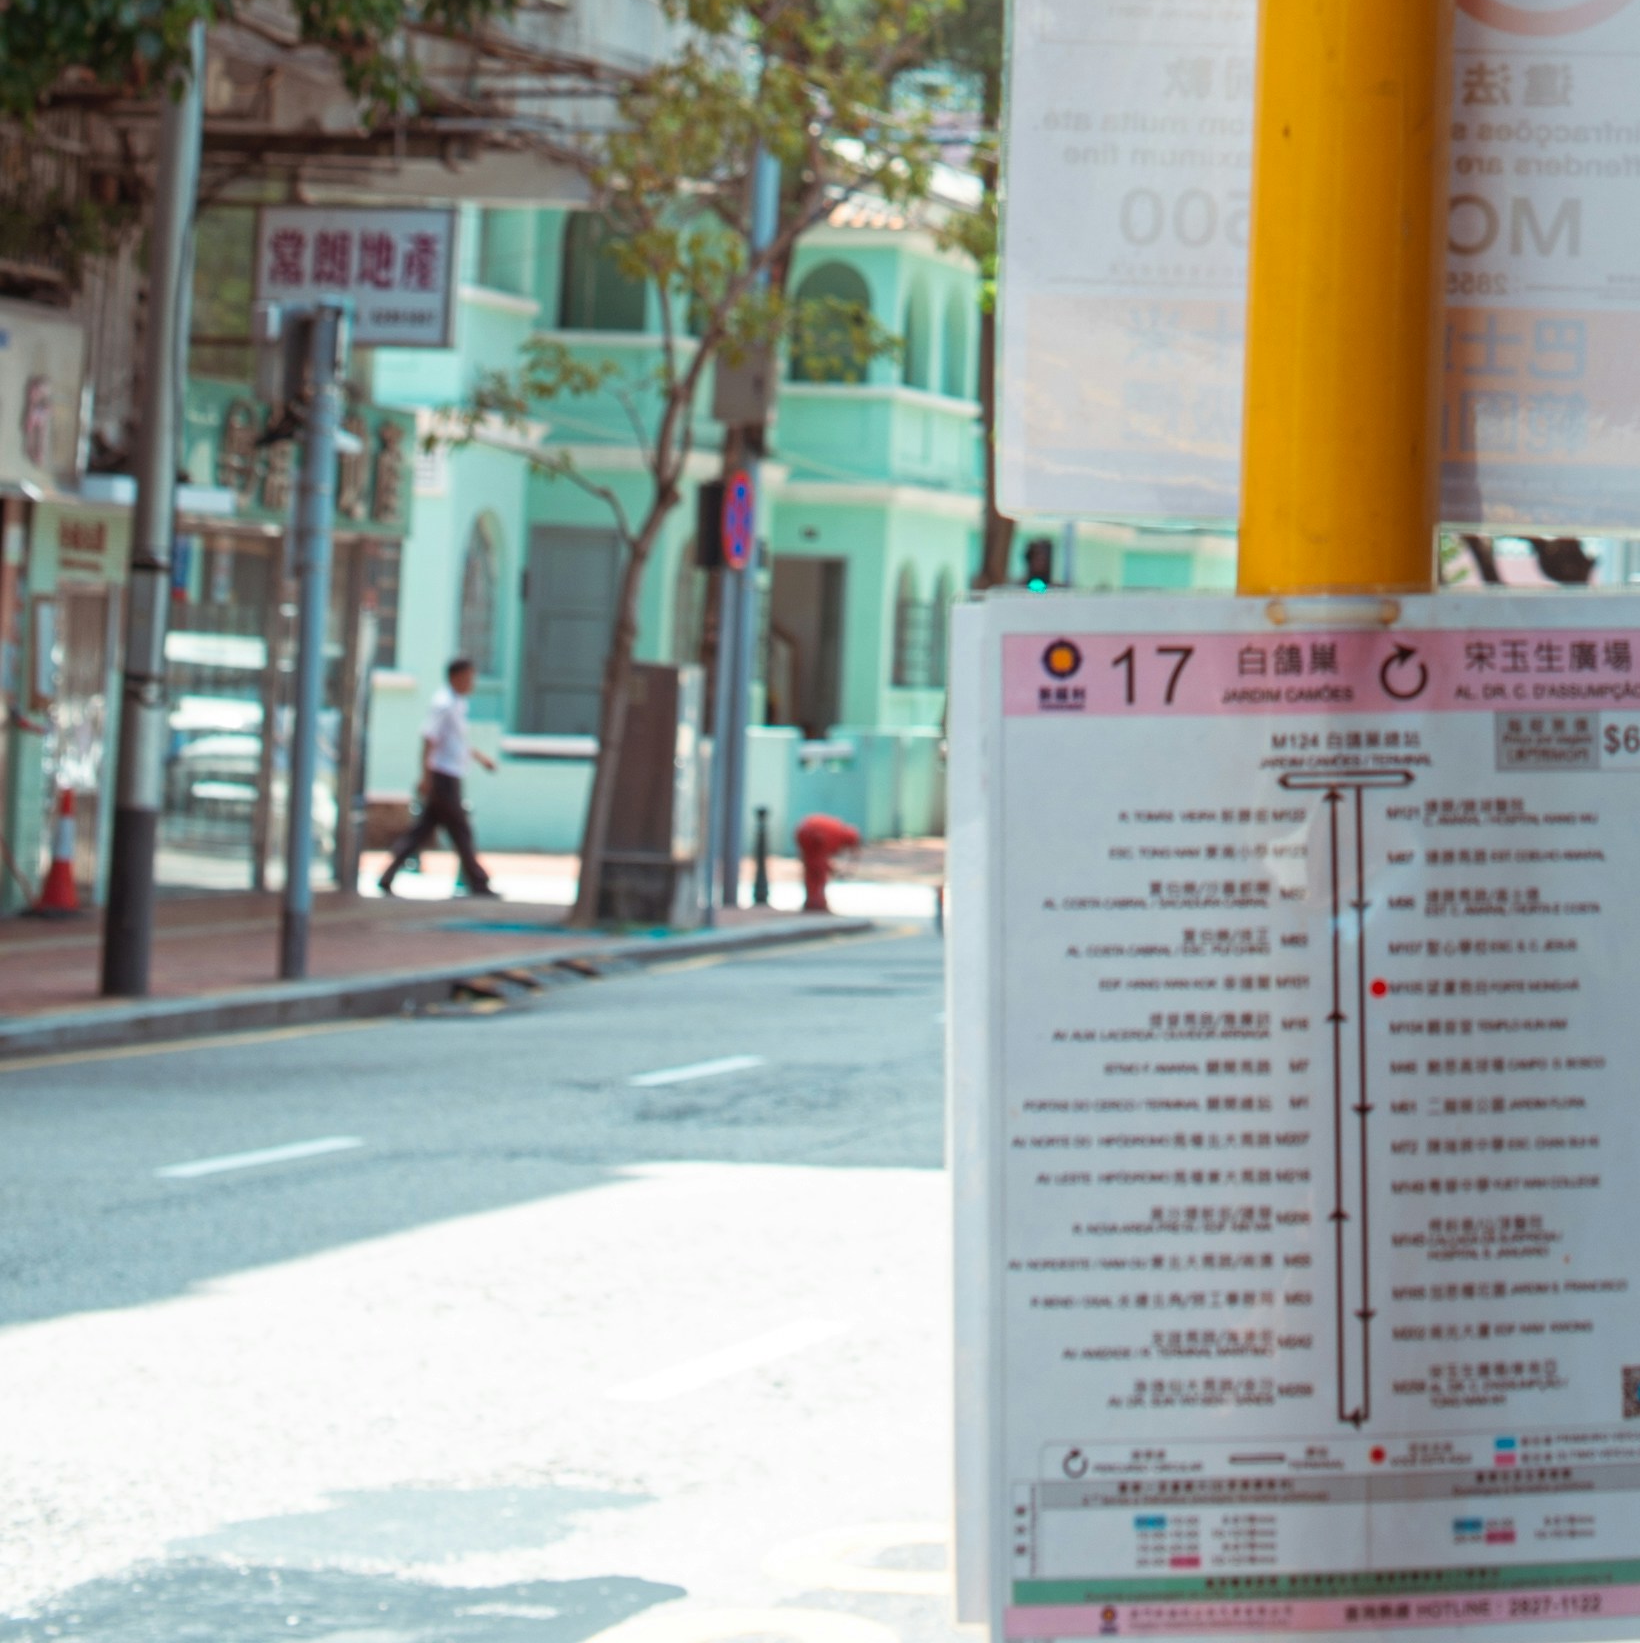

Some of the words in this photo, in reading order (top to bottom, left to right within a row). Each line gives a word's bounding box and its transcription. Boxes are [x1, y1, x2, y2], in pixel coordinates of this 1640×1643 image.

[1466, 639, 1632, 673] 宋玉生廣場
[1112, 645, 1195, 705] 17
[1272, 733, 1319, 749] M124
